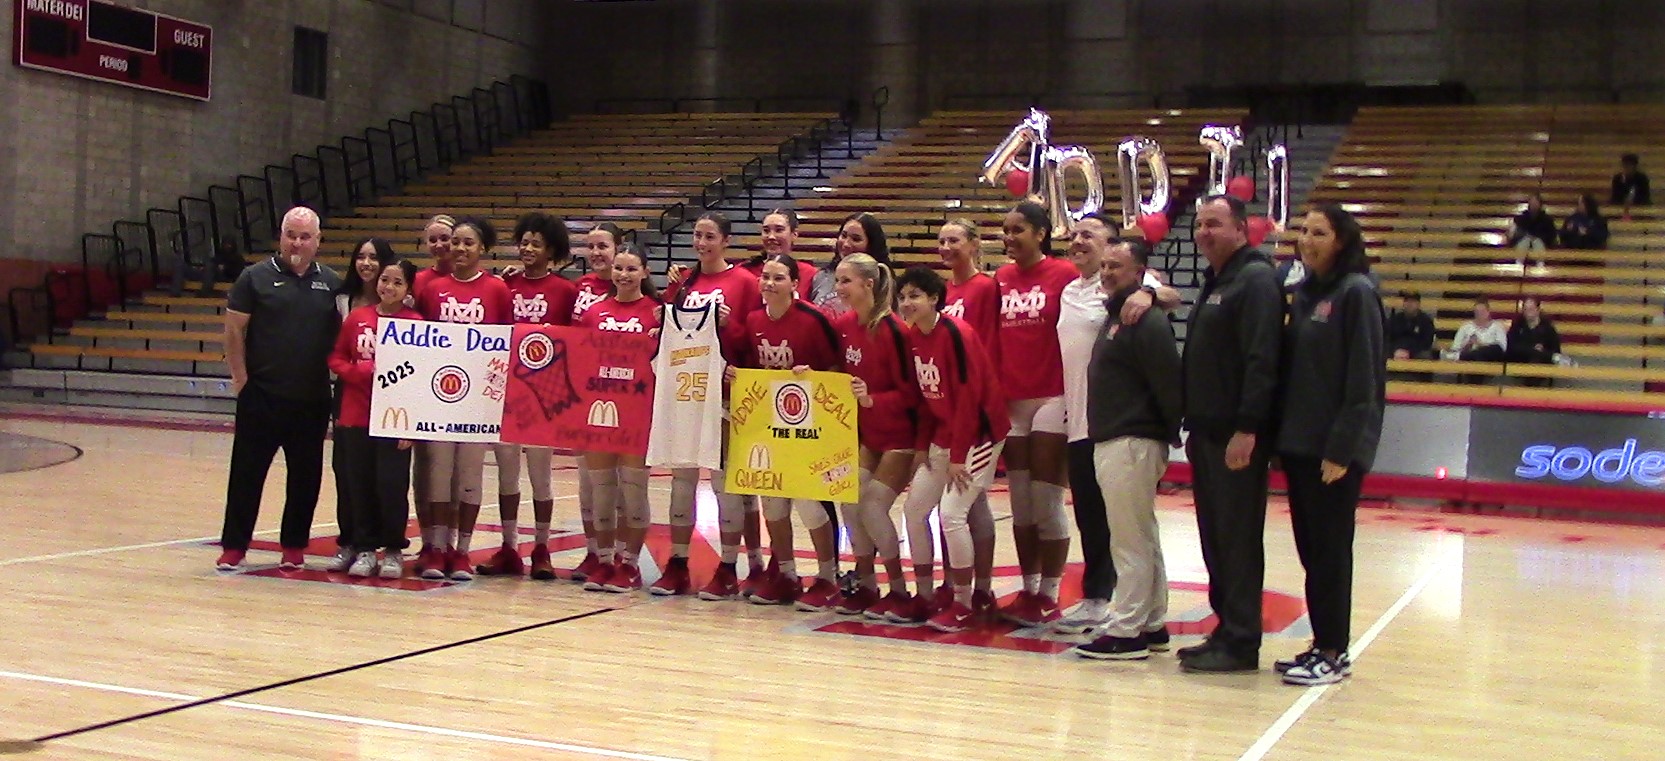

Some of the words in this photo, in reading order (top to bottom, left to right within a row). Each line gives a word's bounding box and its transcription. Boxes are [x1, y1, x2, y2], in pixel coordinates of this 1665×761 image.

[27, 0, 64, 17] MATER
[65, 2, 83, 21] DEI
[174, 28, 204, 49] GUEST
[99, 54, 128, 73] PERIOD
[381, 320, 452, 348] Addie
[466, 327, 514, 352] Dea
[377, 360, 415, 389] 2025
[676, 371, 709, 402] 25
[813, 382, 852, 431] DEAL
[1515, 438, 1665, 487] sode
[735, 468, 783, 491] QUEEN
